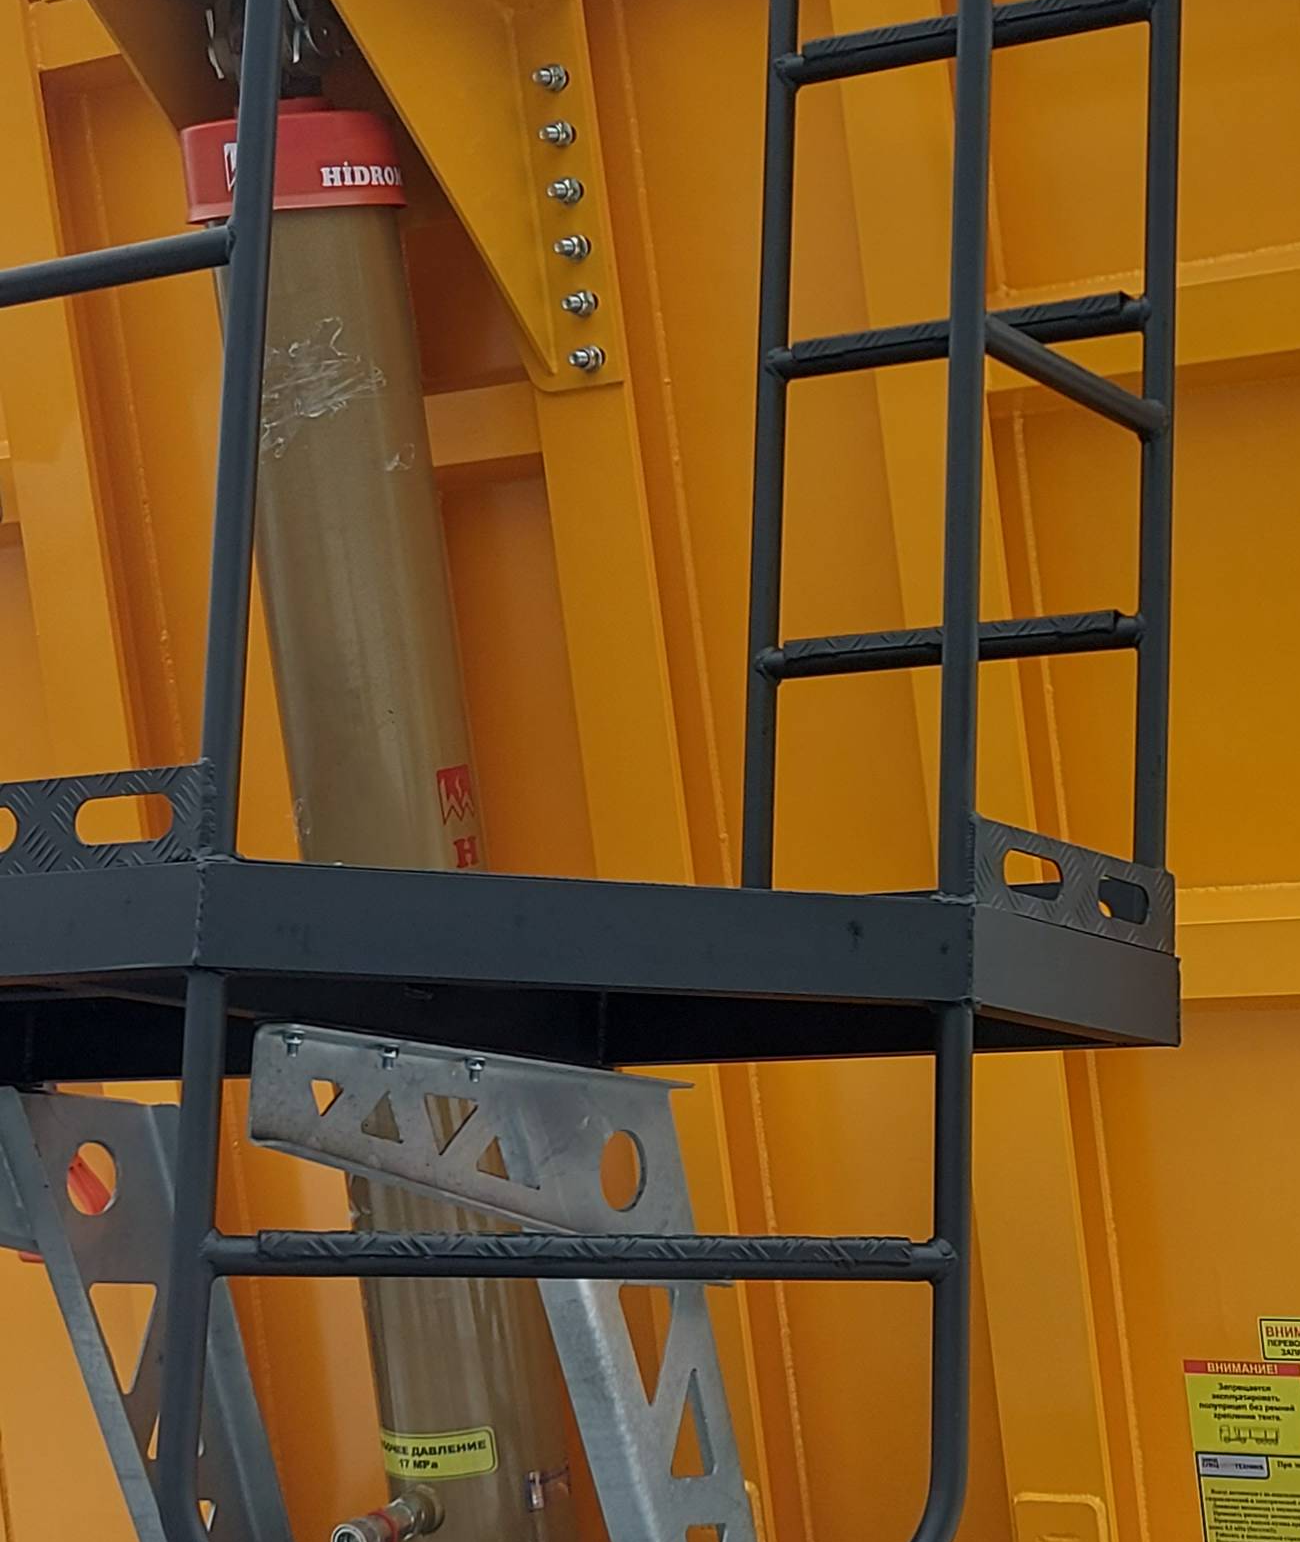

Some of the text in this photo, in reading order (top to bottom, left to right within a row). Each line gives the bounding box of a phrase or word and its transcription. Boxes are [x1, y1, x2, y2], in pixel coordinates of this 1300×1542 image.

[1207, 1362, 1278, 1374] ВНИМАНИЕ!
[411, 1440, 487, 1457] ДАВЛЕНИЕ
[400, 1459, 410, 1469] 17
